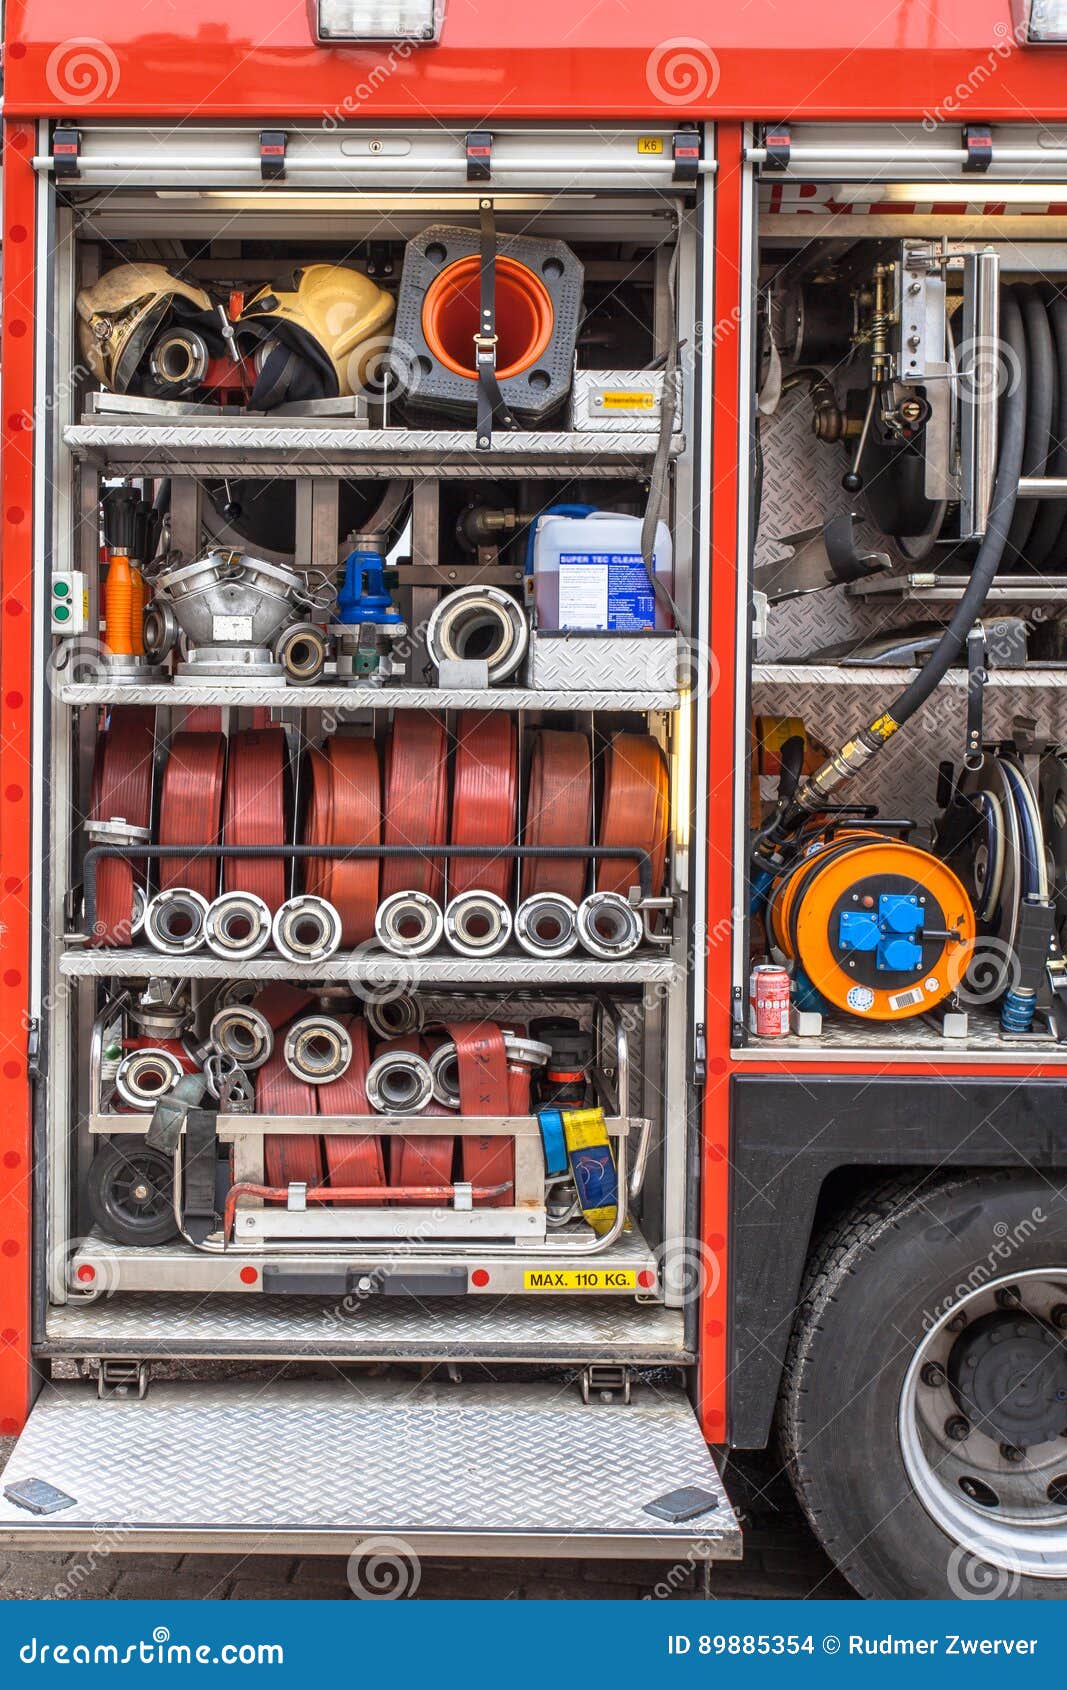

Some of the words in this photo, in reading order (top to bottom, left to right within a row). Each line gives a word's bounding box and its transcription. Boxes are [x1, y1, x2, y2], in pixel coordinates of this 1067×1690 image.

[644, 140, 657, 151] K6
[560, 556, 589, 564] SUPER
[530, 1274, 568, 1286] MAX.
[575, 1274, 598, 1286] 110
[605, 1274, 631, 1286] KG.
